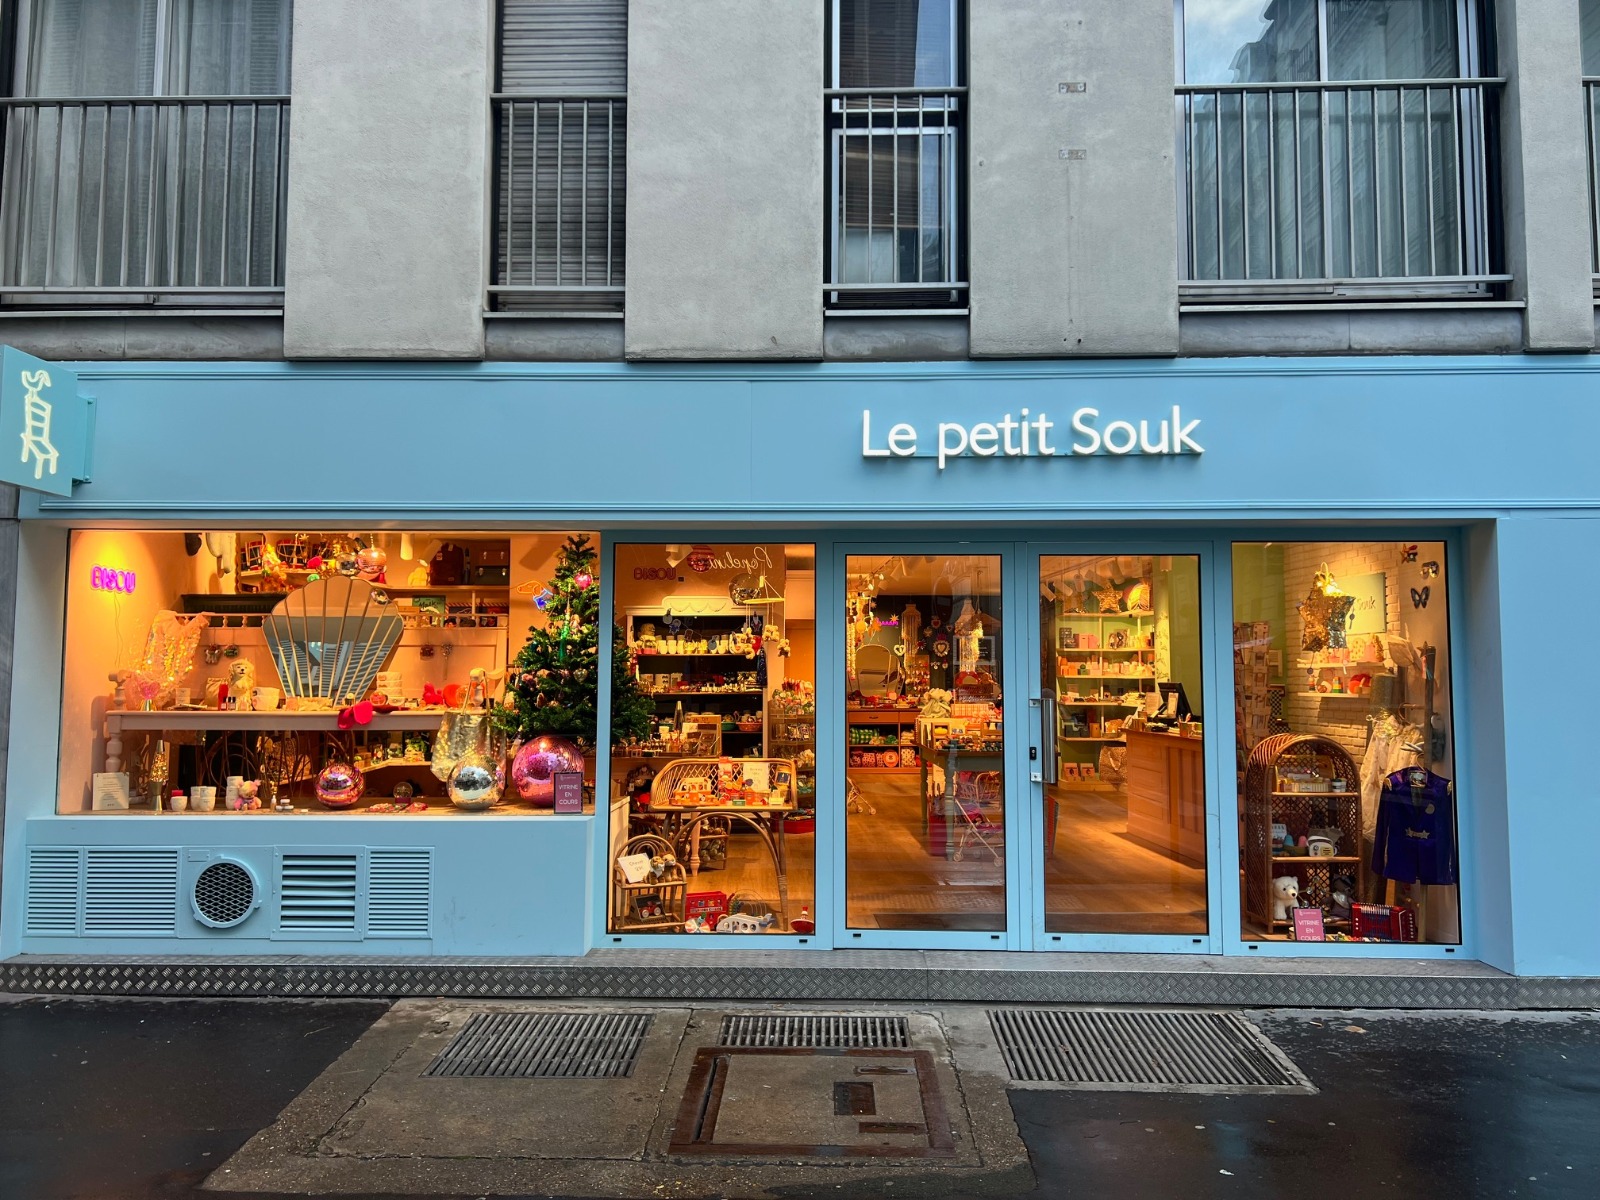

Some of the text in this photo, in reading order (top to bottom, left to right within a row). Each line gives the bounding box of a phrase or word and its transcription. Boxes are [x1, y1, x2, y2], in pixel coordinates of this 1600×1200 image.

[863, 404, 1206, 469] Le petit Souk
[91, 565, 136, 594] BISOU
[633, 567, 677, 581] BISOU
